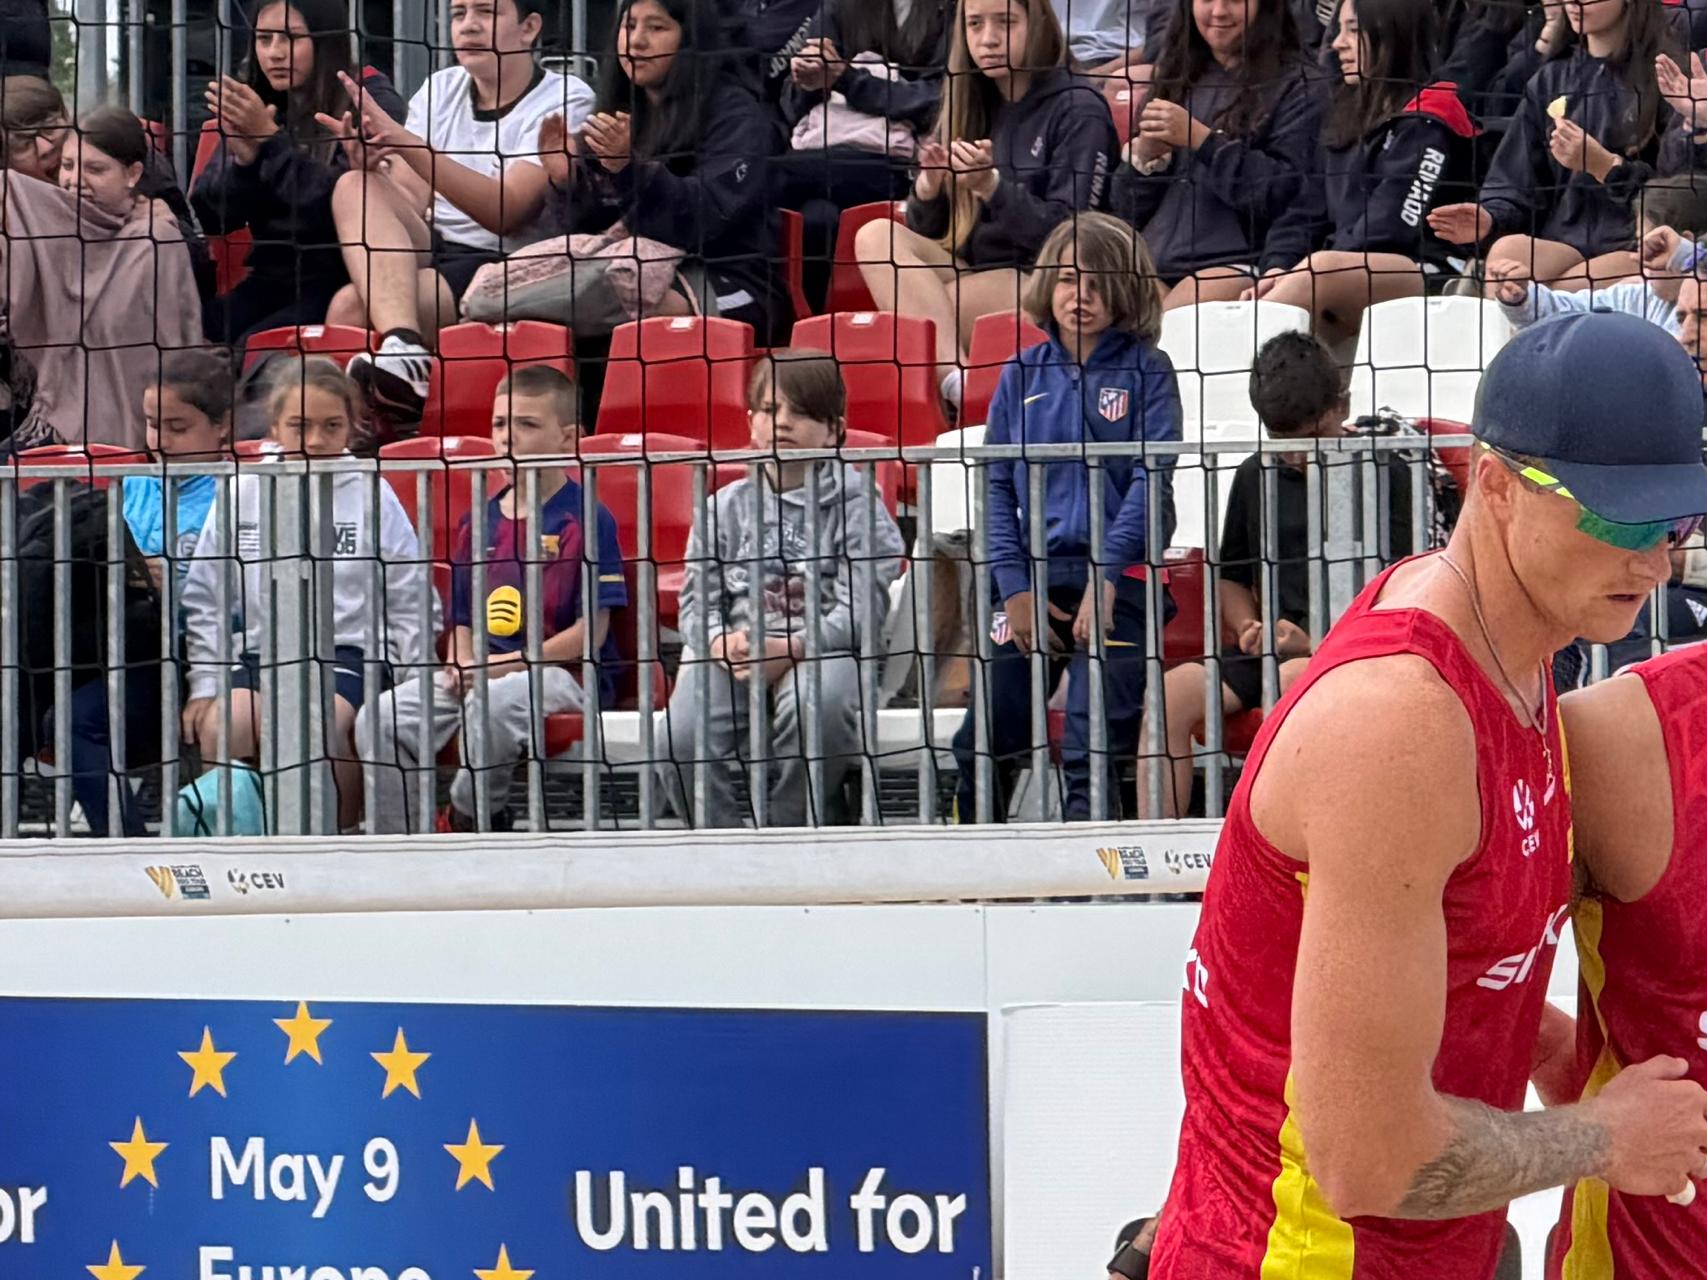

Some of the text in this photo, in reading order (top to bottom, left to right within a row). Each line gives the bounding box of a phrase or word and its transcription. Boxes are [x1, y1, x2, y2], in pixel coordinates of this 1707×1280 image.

[250, 873, 285, 889] CEV
[210, 1136, 400, 1218] May 9
[575, 1166, 967, 1253] United for
